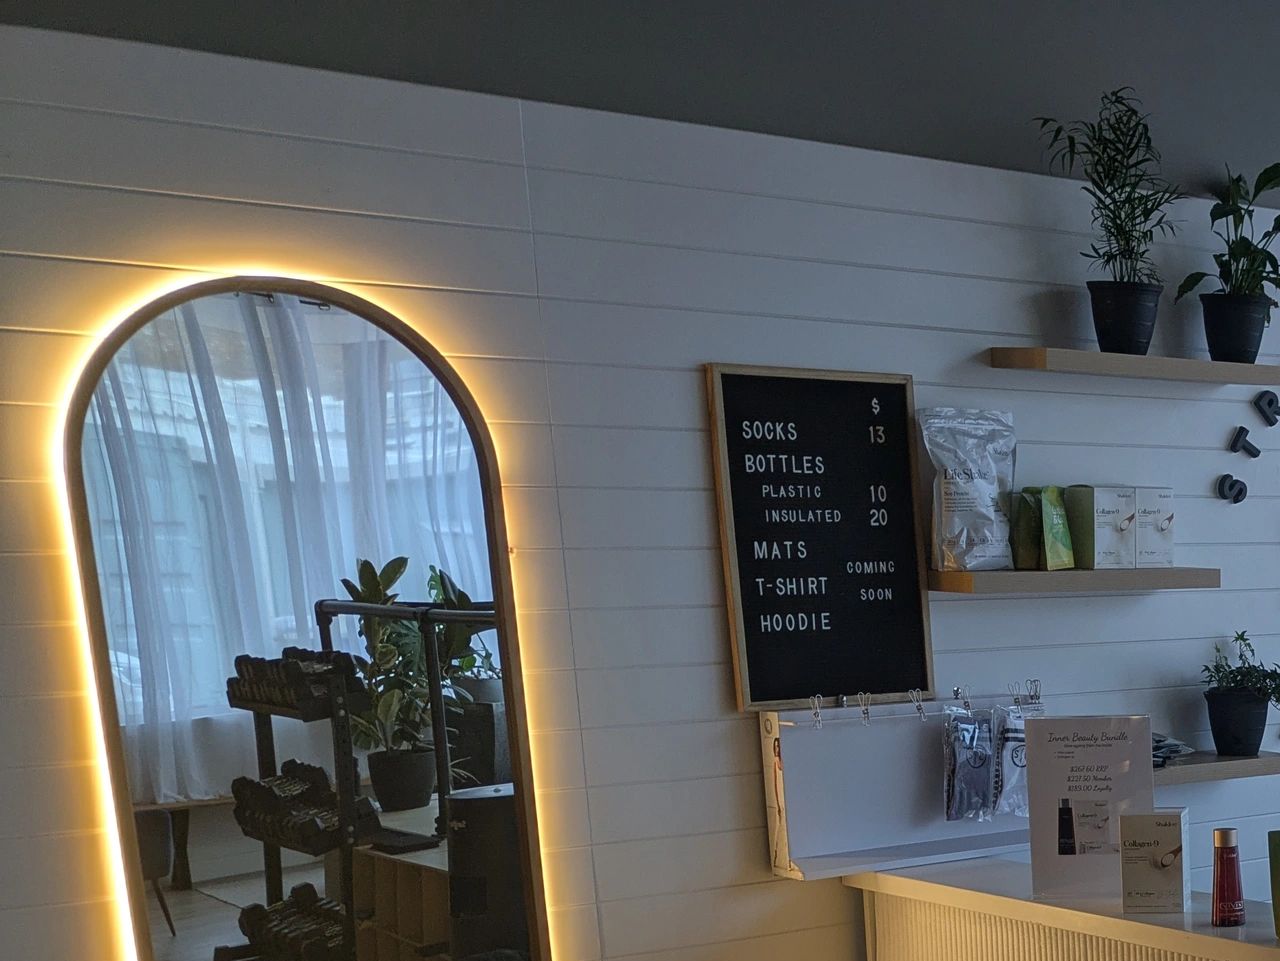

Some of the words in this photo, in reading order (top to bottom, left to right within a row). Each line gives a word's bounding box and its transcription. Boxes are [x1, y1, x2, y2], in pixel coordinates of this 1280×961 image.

[871, 398, 880, 415] $
[742, 421, 798, 441] SOCKS
[868, 425, 885, 444] 13
[745, 454, 825, 474] BOTTLES
[762, 485, 822, 498] PLASTIC
[869, 485, 887, 503] 10
[765, 510, 841, 523] INSULATED
[869, 509, 888, 526] 20
[754, 541, 807, 560] MATS
[846, 561, 895, 574] COMING
[755, 577, 828, 596] T-SHIRT
[860, 588, 892, 601] SOON
[760, 612, 831, 632] HOODIE
[1048, 732, 1069, 743] Inner
[1072, 732, 1098, 744] Beauty
[1101, 731, 1128, 742] Bundle
